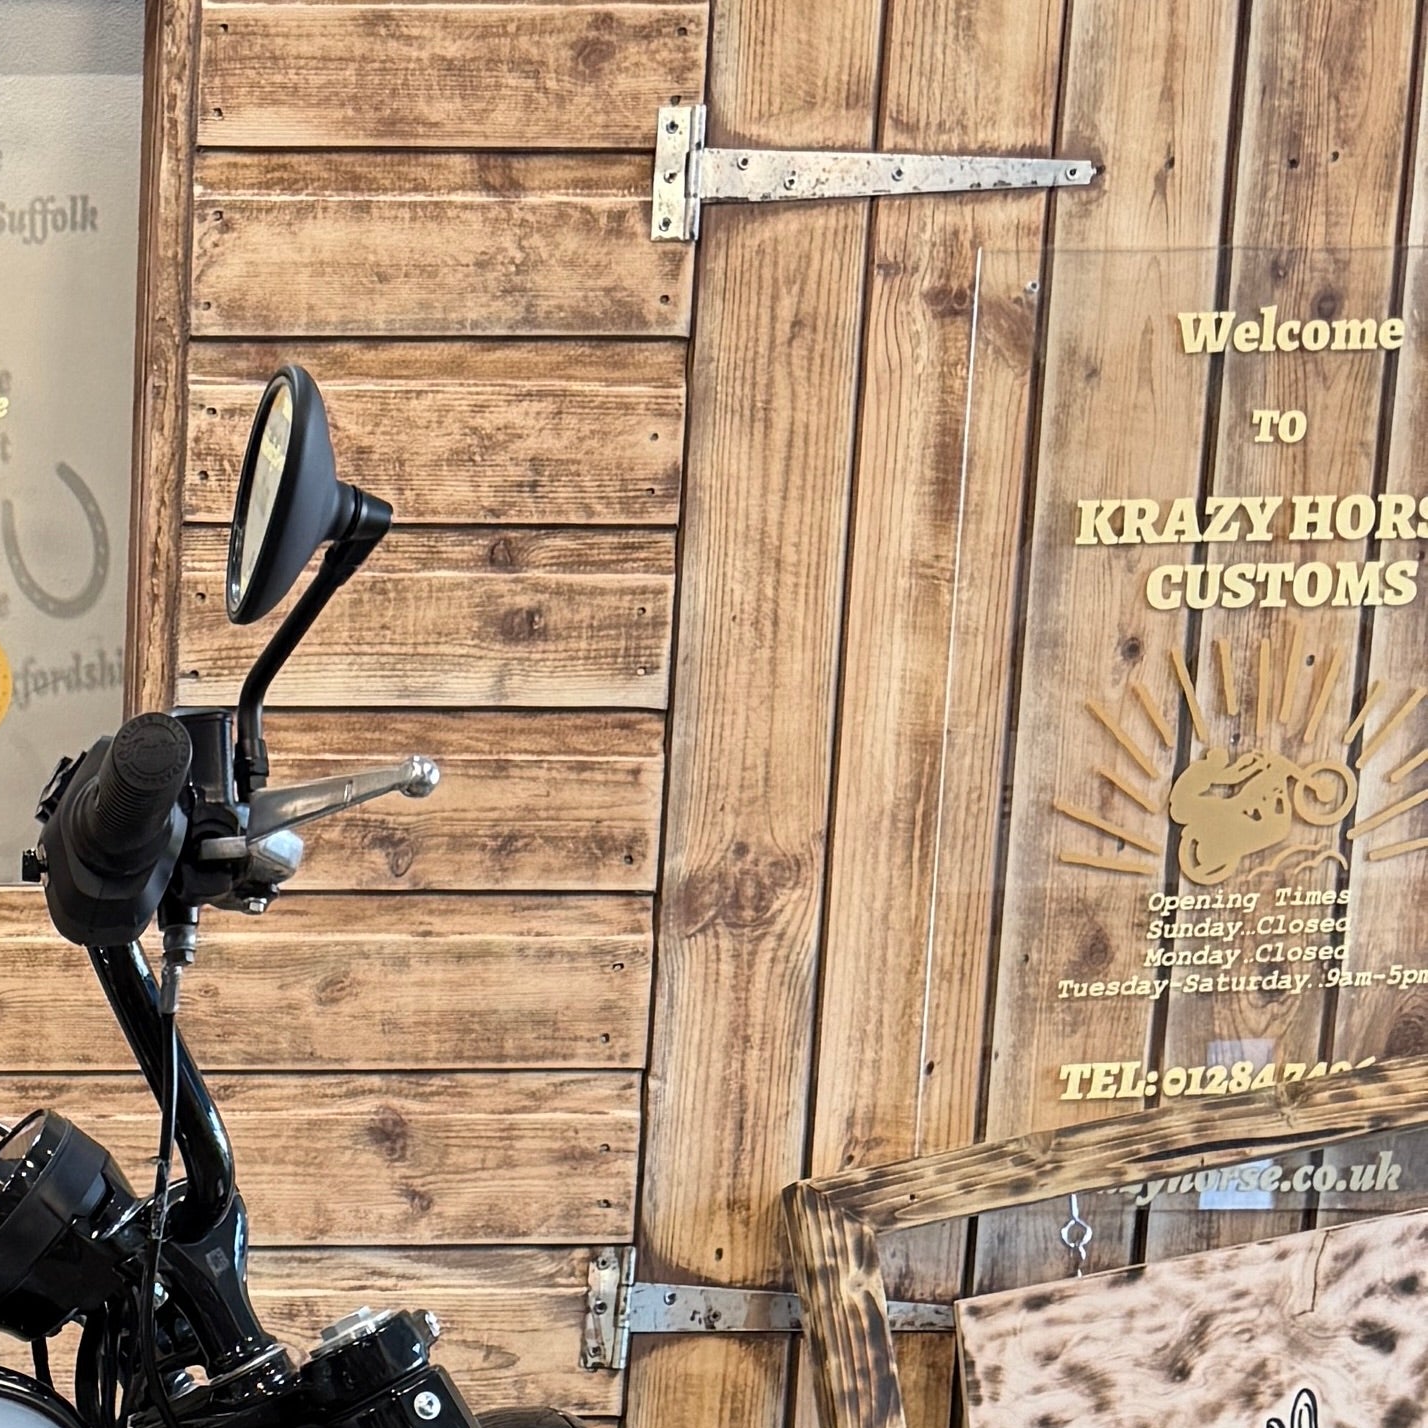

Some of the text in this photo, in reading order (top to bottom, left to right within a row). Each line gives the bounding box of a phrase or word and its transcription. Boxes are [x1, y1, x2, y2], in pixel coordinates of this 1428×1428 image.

[1178, 305, 1406, 354] Welcome
[1253, 409, 1308, 443] TO
[1075, 496, 1284, 545] KRAZY
[1146, 560, 1419, 610] CUSTOMS
[1147, 887, 1353, 917] Opening Times
